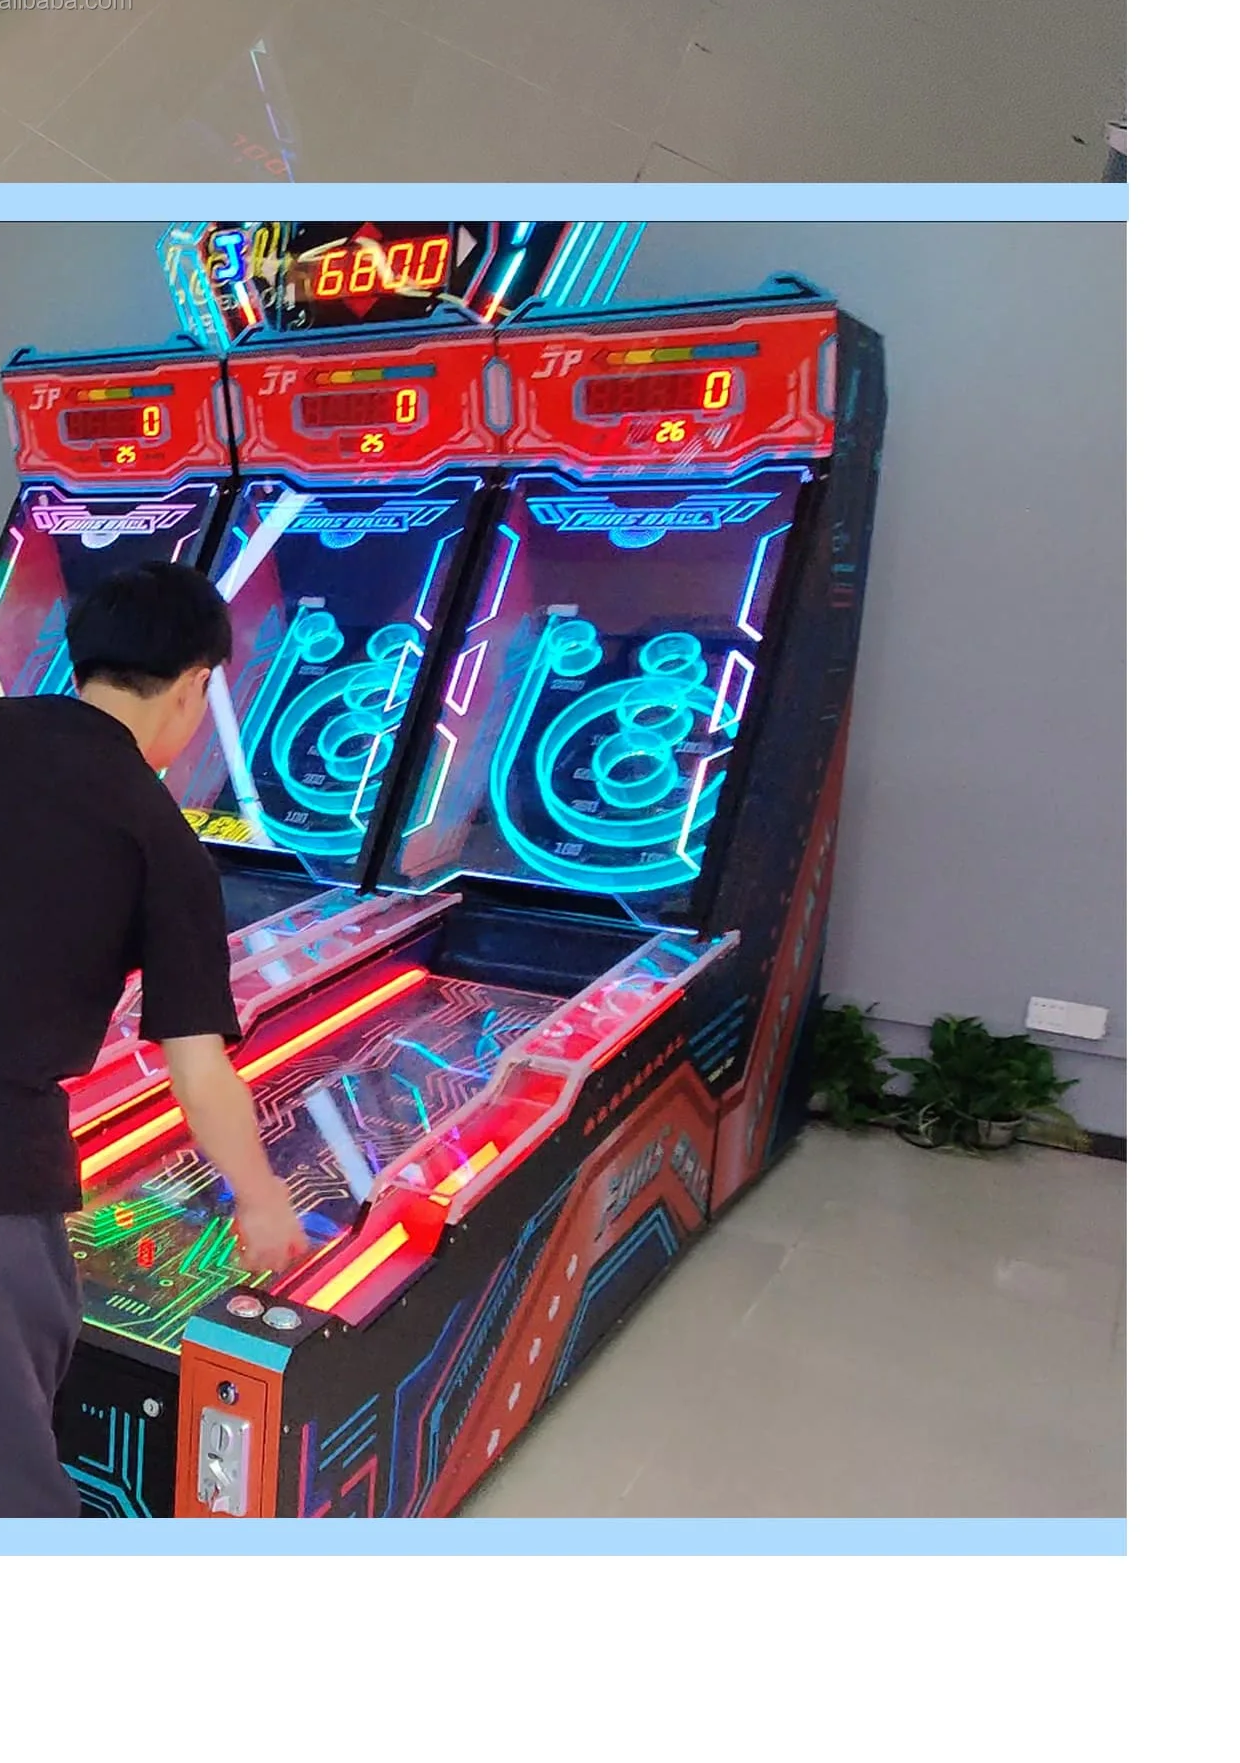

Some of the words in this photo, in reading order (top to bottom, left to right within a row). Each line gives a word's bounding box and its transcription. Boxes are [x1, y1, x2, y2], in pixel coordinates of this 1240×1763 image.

[316, 236, 450, 298] 6800
[702, 369, 733, 410] 0
[142, 405, 161, 436] 0
[396, 389, 418, 424] 0
[360, 433, 385, 453] 25
[655, 418, 686, 443] 26
